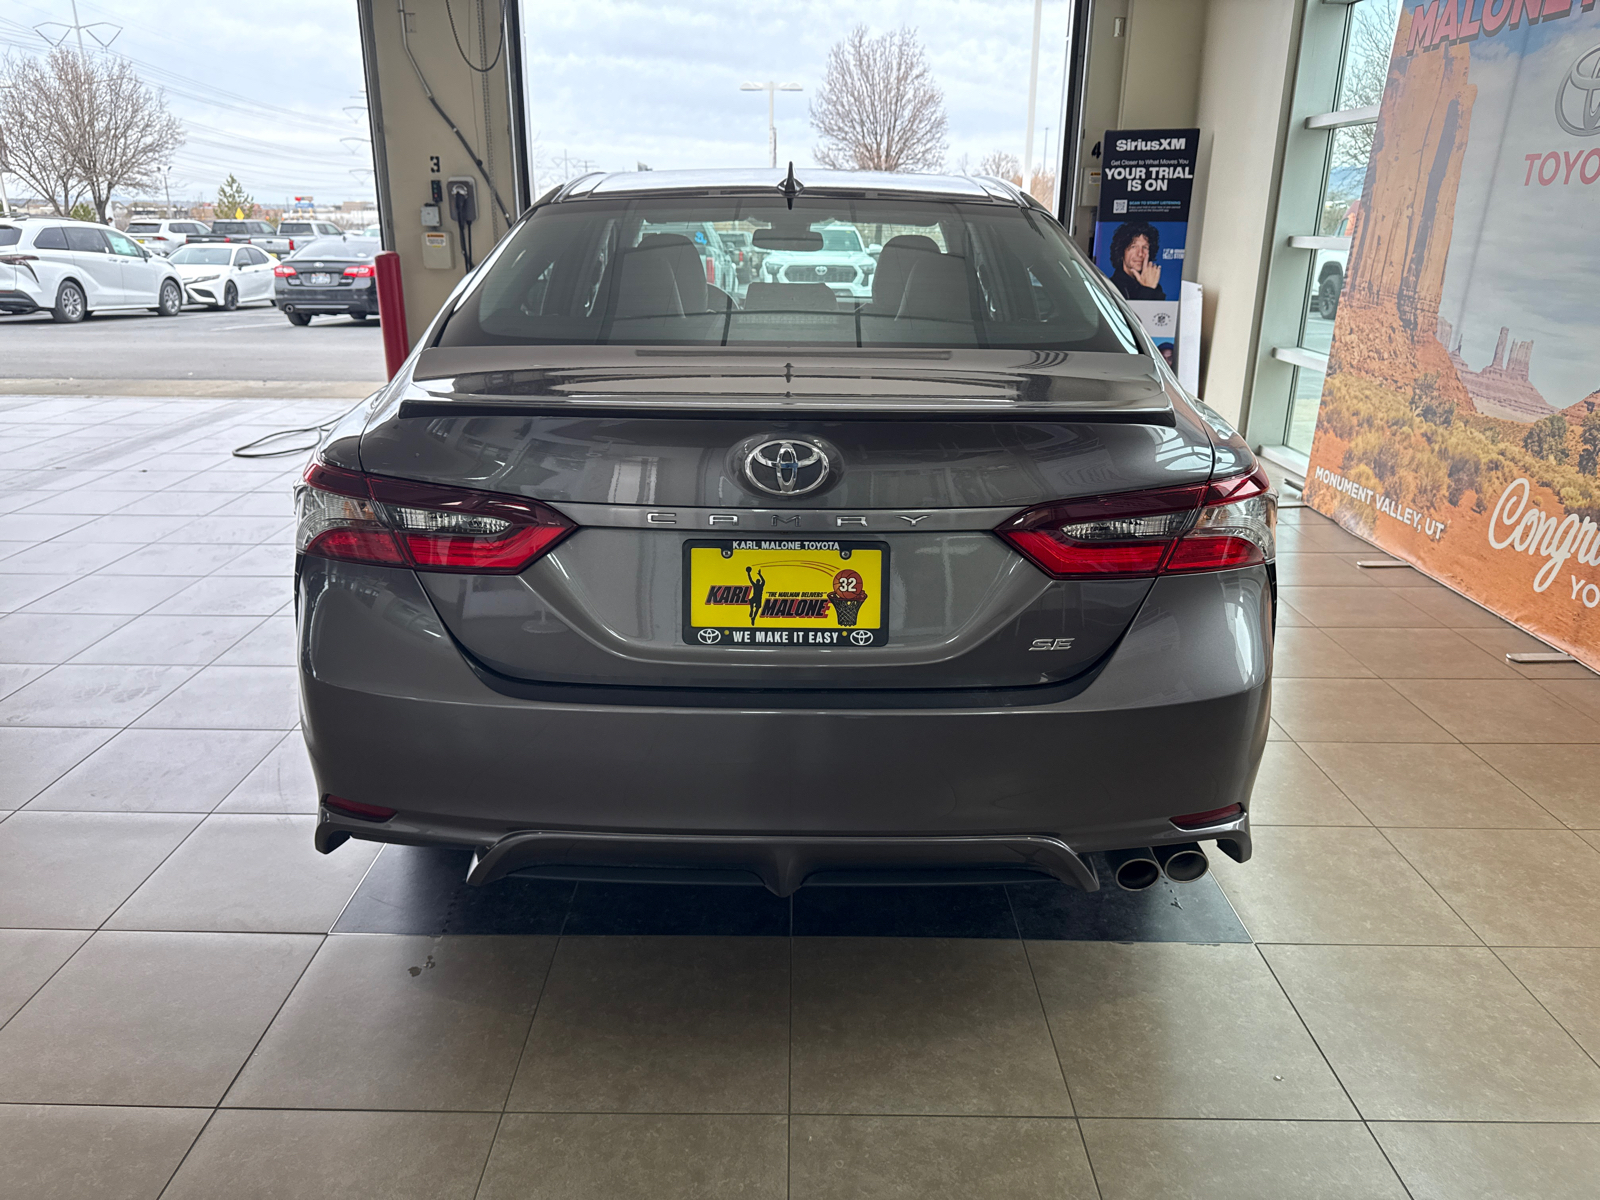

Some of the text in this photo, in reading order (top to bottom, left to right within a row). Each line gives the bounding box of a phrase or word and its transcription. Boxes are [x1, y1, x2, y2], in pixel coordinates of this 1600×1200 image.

[1406, 0, 1573, 56] MALO
[1091, 141, 1101, 159] 4
[1116, 138, 1186, 151] SiriusXM
[430, 156, 440, 173] 3
[1524, 148, 1600, 186] TOYO
[1105, 167, 1146, 180] YOUR
[1149, 166, 1193, 179] TRIAL
[1127, 179, 1168, 192] IS ON
[1315, 466, 1445, 540] MONUMENT VALLEY, UT
[646, 512, 933, 528] CAMRY
[733, 541, 840, 551] KARL MALONE TOYOTA
[839, 578, 857, 592] 32
[1571, 575, 1600, 608] YO
[706, 585, 751, 605] KARL
[760, 598, 830, 619] MALONE
[733, 631, 839, 644] WE MAKE IT EASY
[1028, 637, 1076, 651] SE
